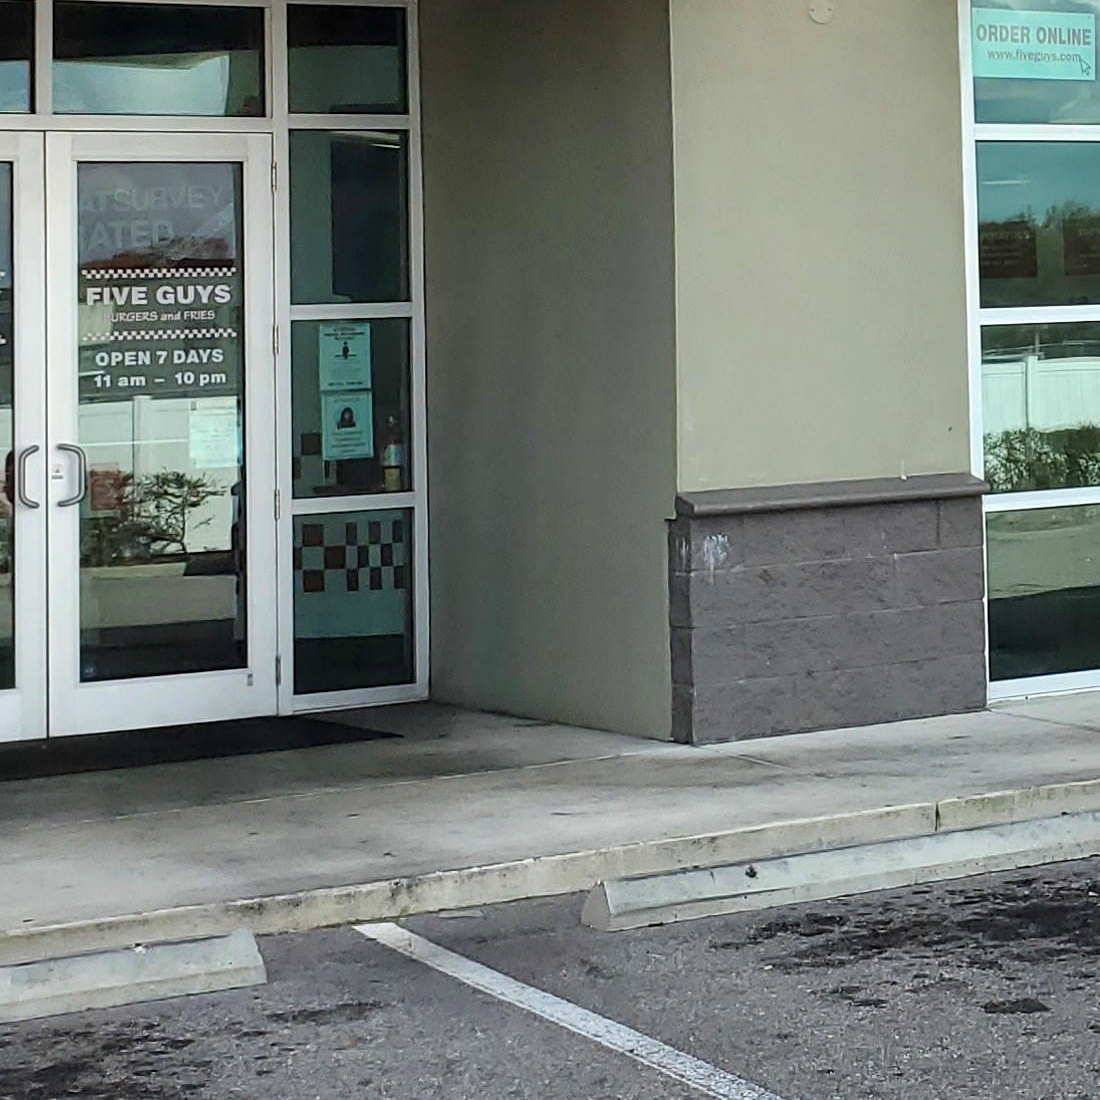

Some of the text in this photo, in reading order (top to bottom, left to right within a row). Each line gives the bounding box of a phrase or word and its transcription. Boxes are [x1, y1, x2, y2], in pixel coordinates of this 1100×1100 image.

[976, 24, 1092, 46] ORDER ONLINE
[987, 49, 1081, 63] www.fiveguys.com
[86, 285, 231, 305] FIVE GUYS
[160, 311, 181, 321] and
[183, 310, 215, 320] FRIES
[95, 349, 224, 366] OPEN 7 DAYS
[94, 375, 111, 387] 11
[118, 375, 146, 387] am
[174, 372, 194, 385] 10
[200, 372, 226, 386] pm
